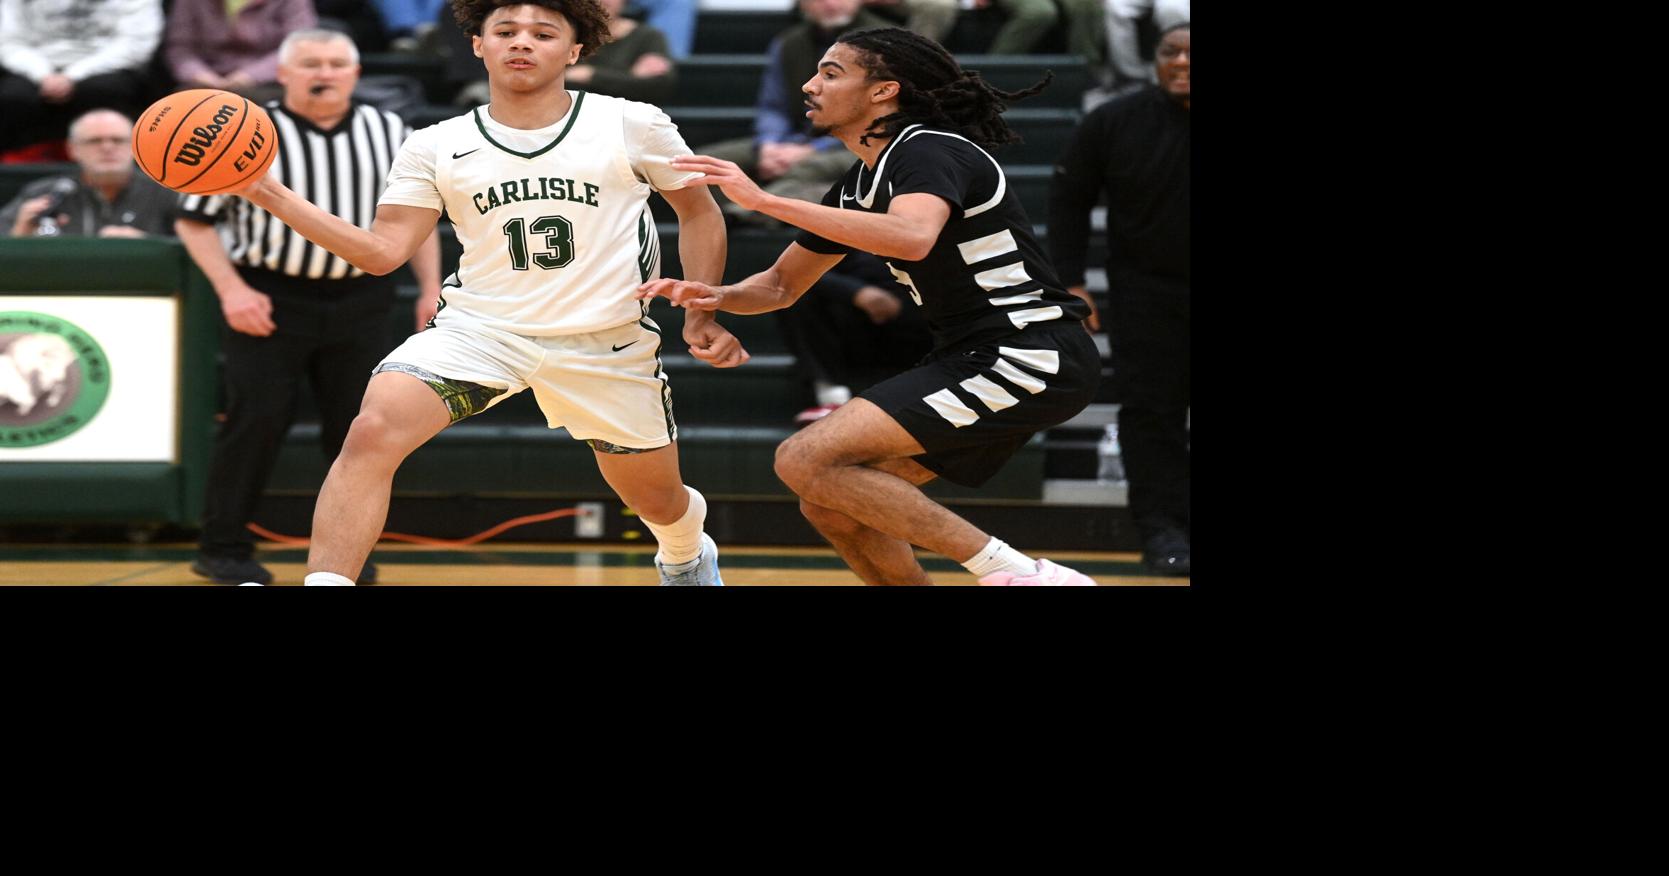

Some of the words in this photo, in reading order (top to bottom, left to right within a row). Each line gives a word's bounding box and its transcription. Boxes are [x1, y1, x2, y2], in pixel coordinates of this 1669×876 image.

[174, 104, 238, 167] Wilson
[233, 131, 265, 173] EVO
[473, 177, 599, 215] CARLISLE
[503, 215, 575, 270] 13
